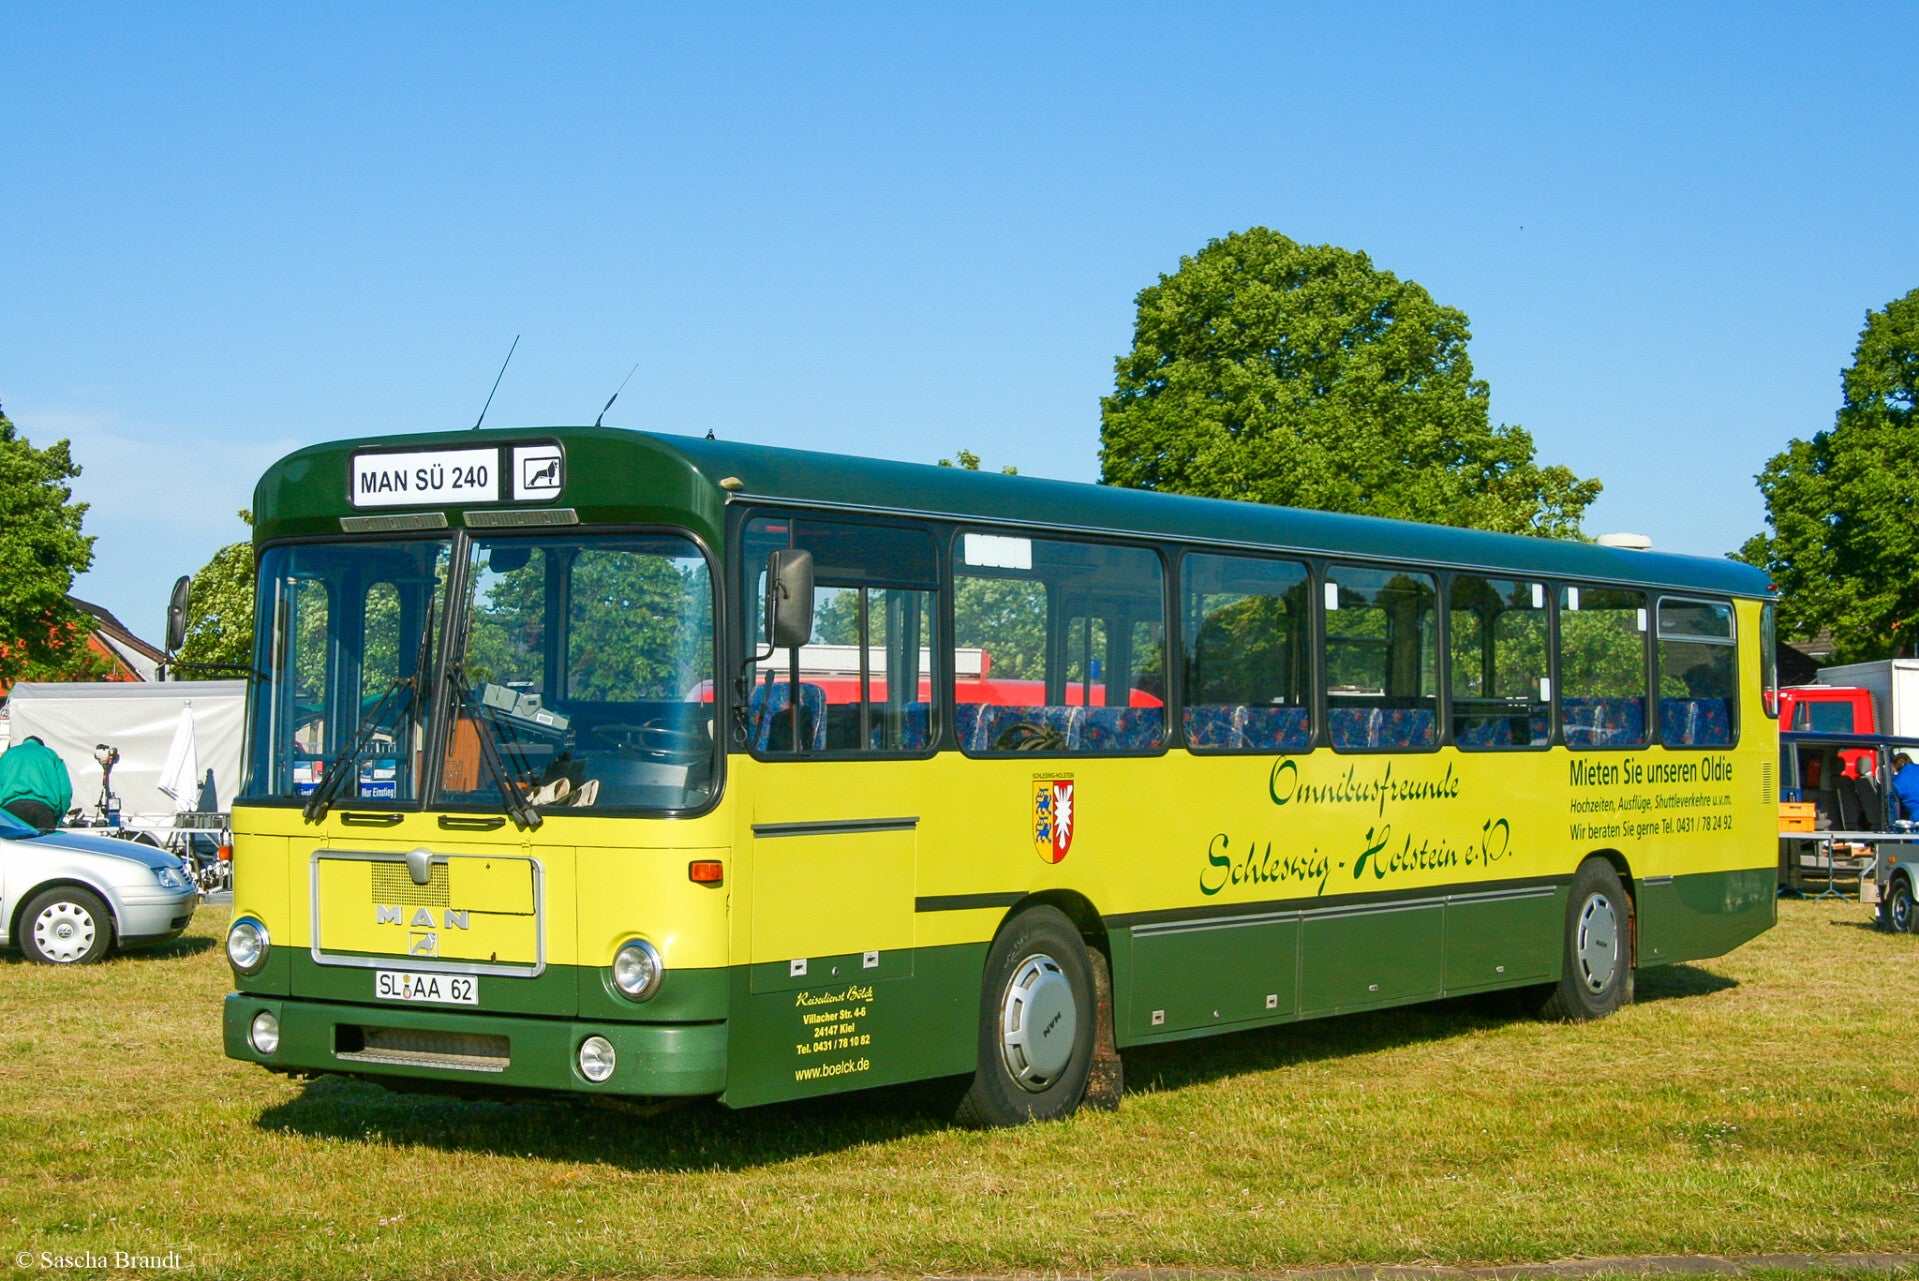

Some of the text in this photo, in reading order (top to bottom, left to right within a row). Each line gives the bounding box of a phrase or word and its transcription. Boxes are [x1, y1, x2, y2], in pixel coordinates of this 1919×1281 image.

[361, 463, 488, 493] MAN SÜ 240
[1570, 755, 1733, 786] Mieten Sie unseren Oldie
[361, 785, 394, 798] Nur Einstieg
[1269, 755, 1460, 818] Omnibusfreunde
[1570, 797, 1616, 813] Hochzeiten,
[1618, 794, 1652, 814] Ausflüge,
[1655, 792, 1710, 809] Shuttleverkehre
[1570, 823, 1585, 840] Wir
[1588, 824, 1620, 839] beraten
[1623, 820, 1634, 837] Sie
[1636, 822, 1659, 840] gerne
[1662, 818, 1673, 834] Tel.
[1676, 817, 1694, 832] 0431
[1702, 816, 1710, 831] 78
[1713, 815, 1722, 830] 24
[1723, 815, 1732, 830] 92
[1199, 833, 1331, 896] Schleswig
[1353, 824, 1457, 879] Holstein
[376, 904, 469, 930] MAN
[380, 974, 472, 1000] SL AA 62
[796, 991, 845, 1007] Reisedienst
[803, 1007, 866, 1025] Villacher Str. 4-6
[814, 1023, 855, 1038] 24147 Kiel
[796, 1044, 811, 1055] Tel.
[813, 1040, 832, 1052] 0431
[839, 1038, 848, 1049] 78
[850, 1037, 859, 1047] 10
[860, 1035, 870, 1045] 82
[795, 1057, 870, 1082] www.boelck.de
